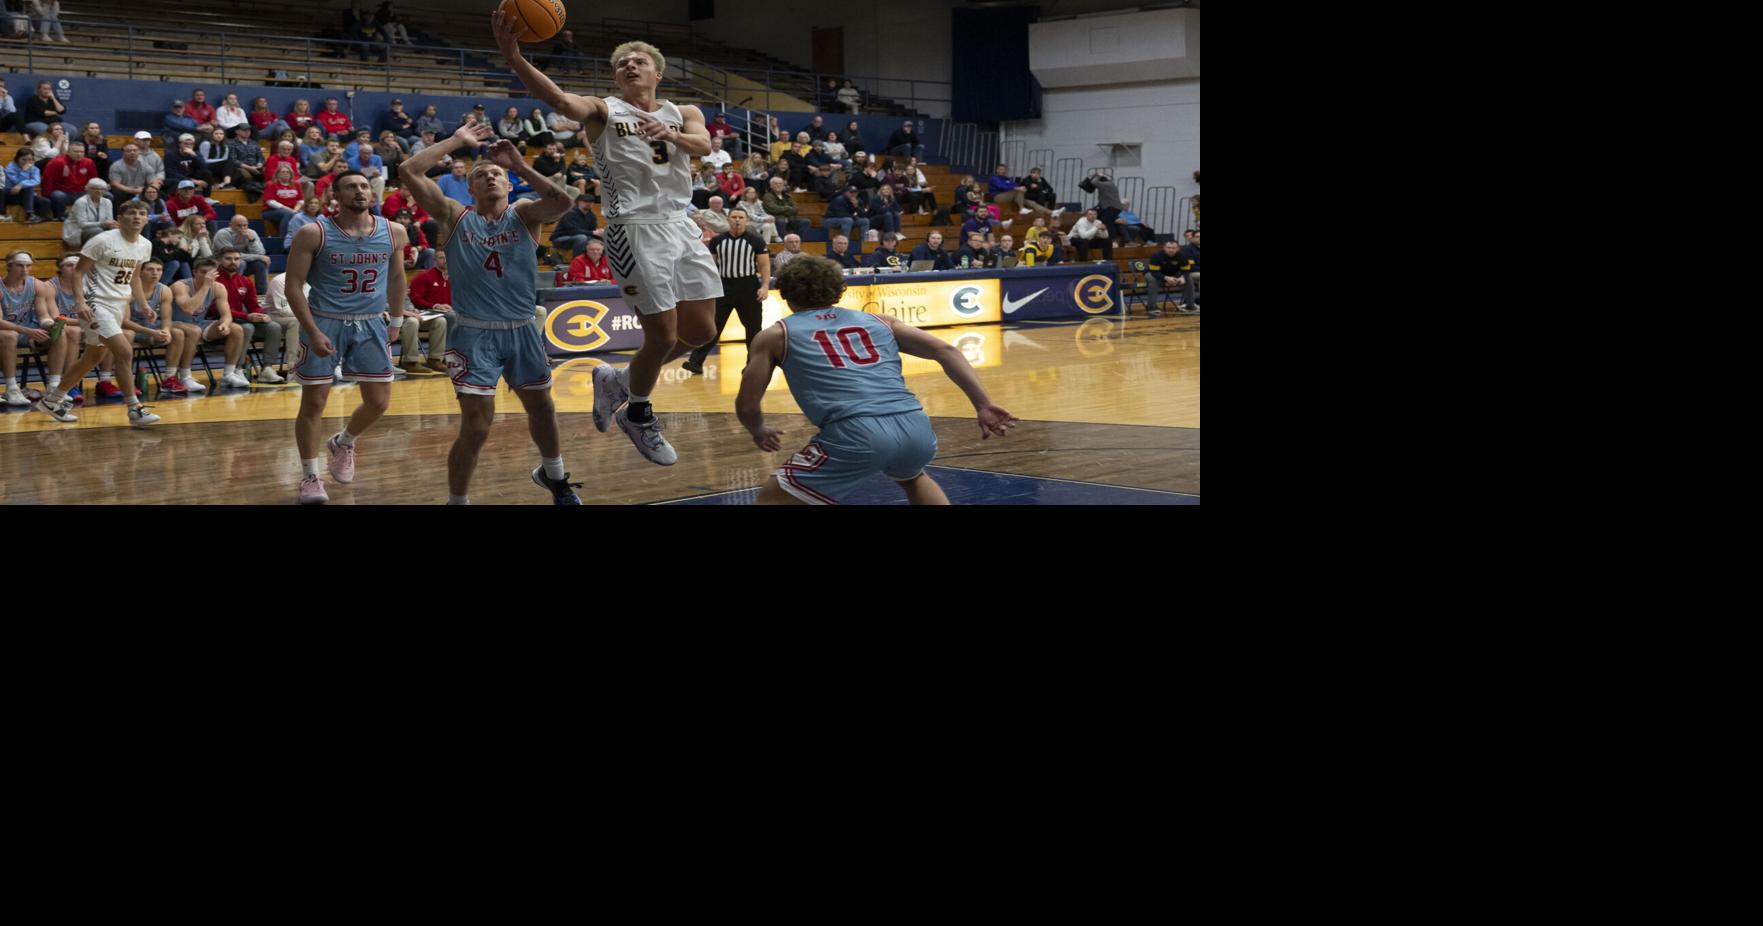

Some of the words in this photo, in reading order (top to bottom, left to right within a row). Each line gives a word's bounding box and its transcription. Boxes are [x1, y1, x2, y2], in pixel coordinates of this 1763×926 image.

[650, 140, 670, 165] 3
[349, 251, 388, 265] JOHN'S
[482, 250, 505, 279] 4
[340, 268, 378, 294] 32
[878, 286, 927, 298] Wisconsin
[611, 313, 642, 331] #RO
[811, 325, 881, 369] 10
